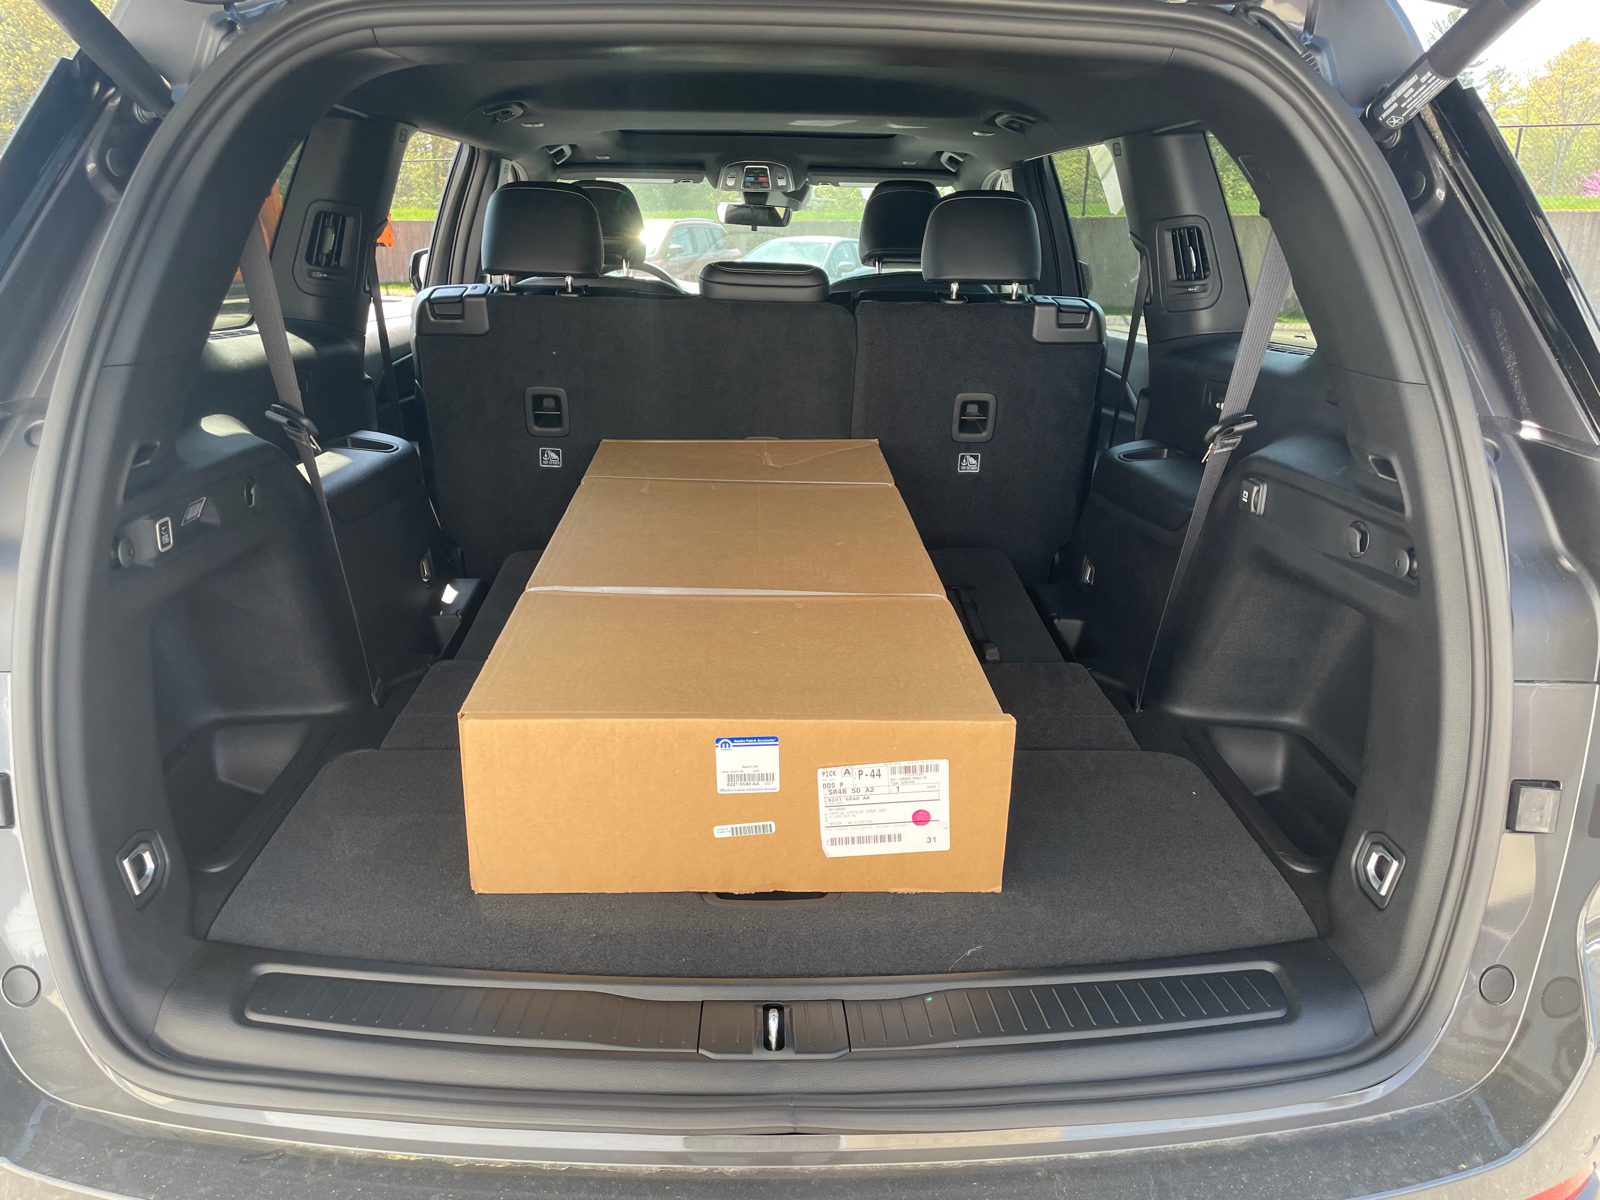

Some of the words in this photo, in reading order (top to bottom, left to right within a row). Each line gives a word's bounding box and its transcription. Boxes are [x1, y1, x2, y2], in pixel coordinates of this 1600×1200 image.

[843, 768, 851, 776] A
[858, 768, 882, 780] P-44
[828, 788, 847, 796] SR48
